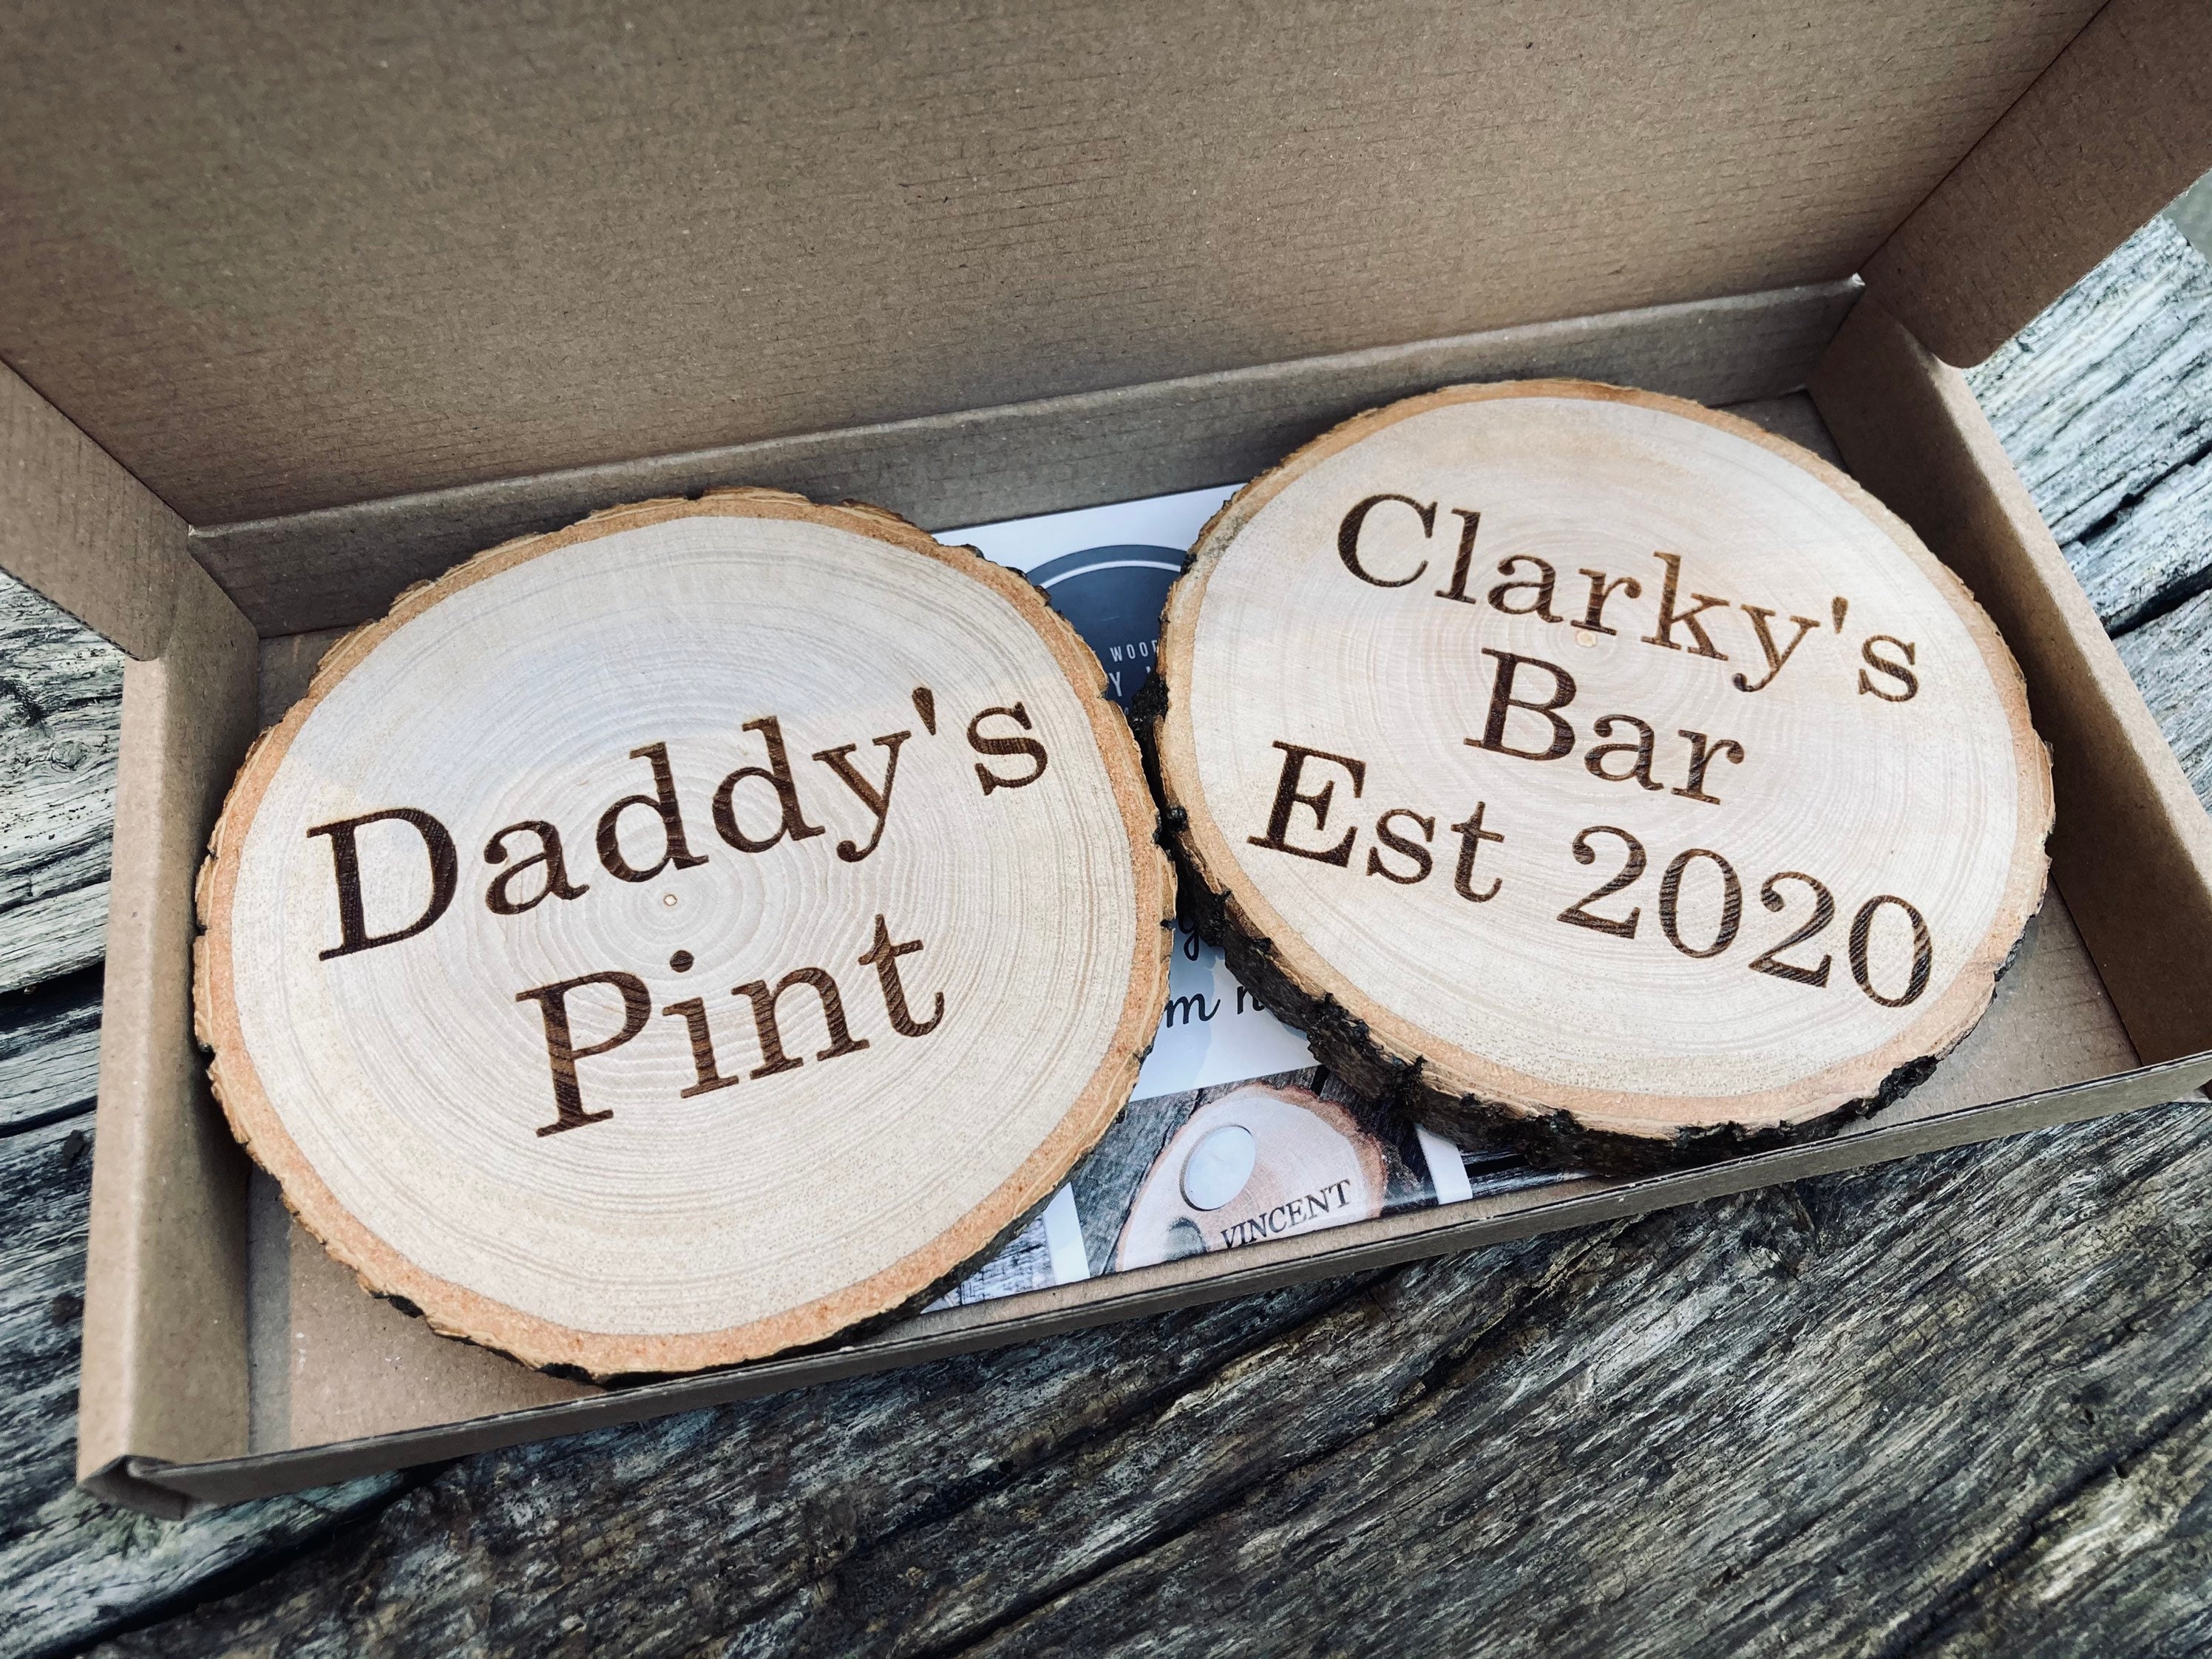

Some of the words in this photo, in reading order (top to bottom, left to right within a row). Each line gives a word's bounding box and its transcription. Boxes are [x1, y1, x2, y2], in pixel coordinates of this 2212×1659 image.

[1337, 494, 1919, 703] Clarky's
[306, 686, 1048, 962] Daddy's
[1464, 648, 1745, 806] Bar
[1247, 740, 1505, 903] Est
[1557, 826, 1933, 1008] 2020
[515, 914, 945, 1138] Pint
[1220, 1178, 1351, 1249] VINCENT
